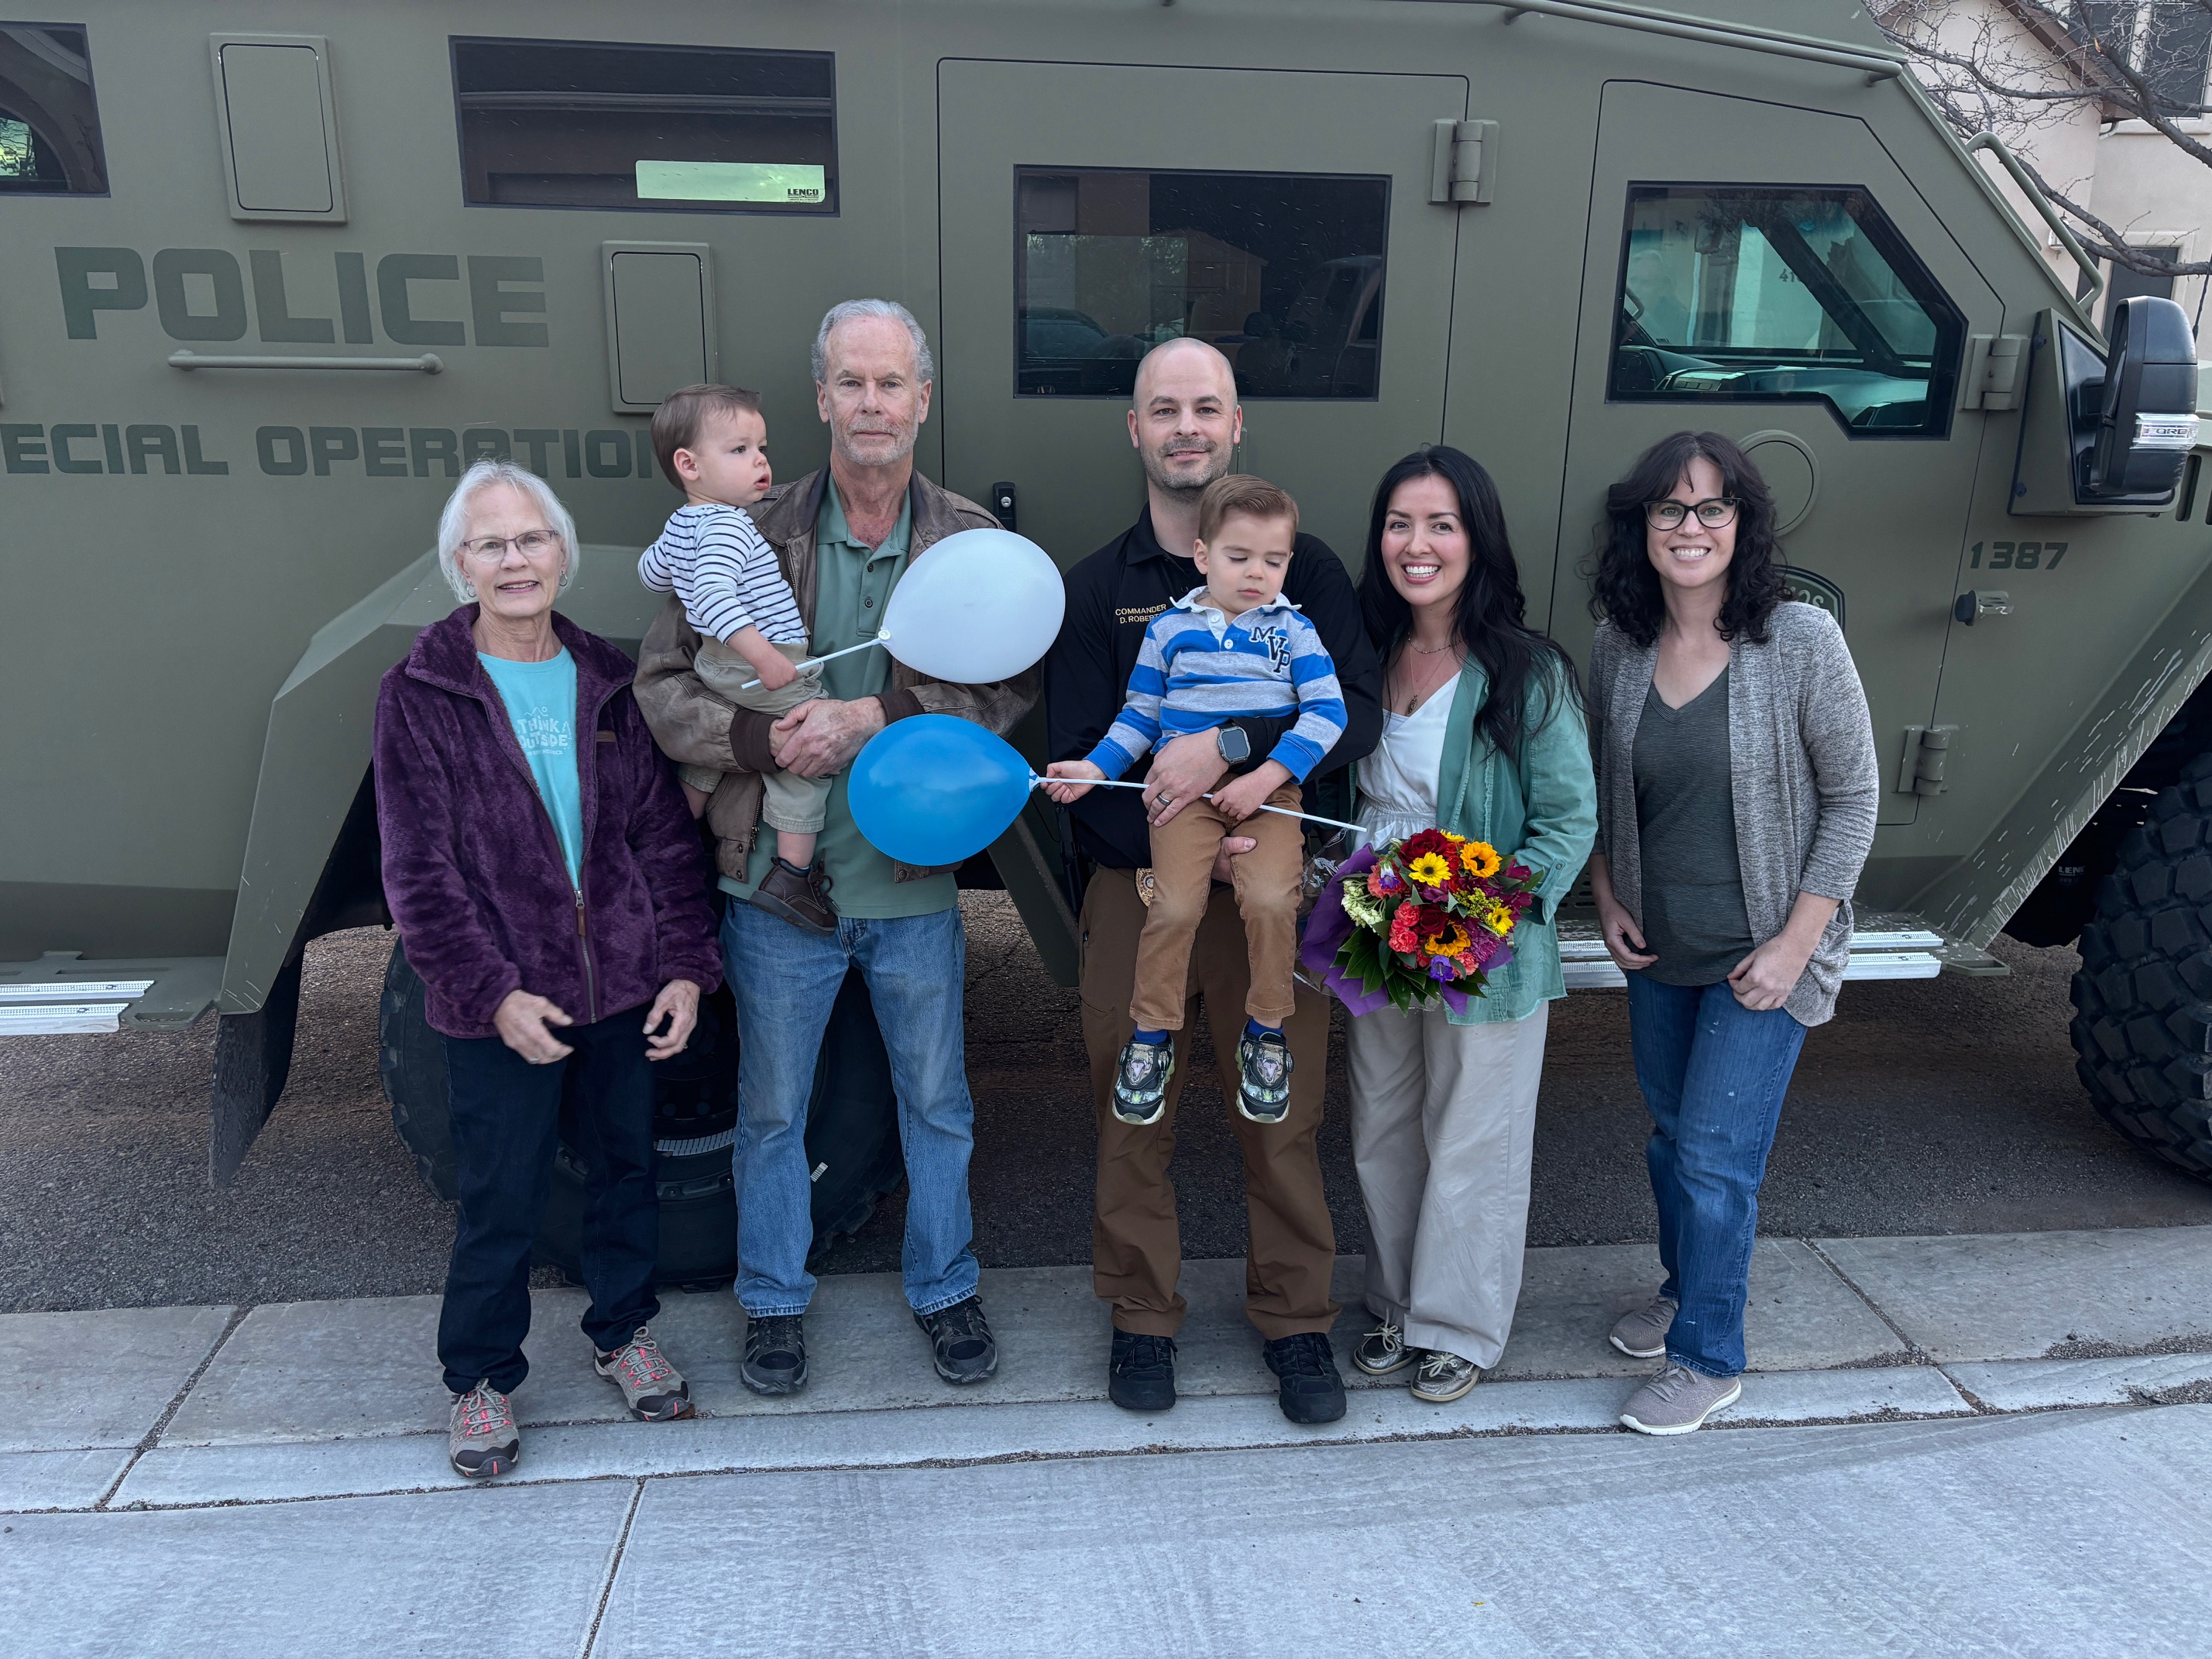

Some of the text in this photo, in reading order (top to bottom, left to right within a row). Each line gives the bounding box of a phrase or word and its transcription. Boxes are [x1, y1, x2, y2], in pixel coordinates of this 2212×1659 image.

[54, 246, 550, 348] POLICE
[0, 423, 229, 475] ECIAL
[1970, 541, 2069, 570] 1387
[1115, 603, 1167, 616] COMMANDER
[1128, 613, 1162, 623] ROBERT
[1249, 626, 1291, 674] MVP
